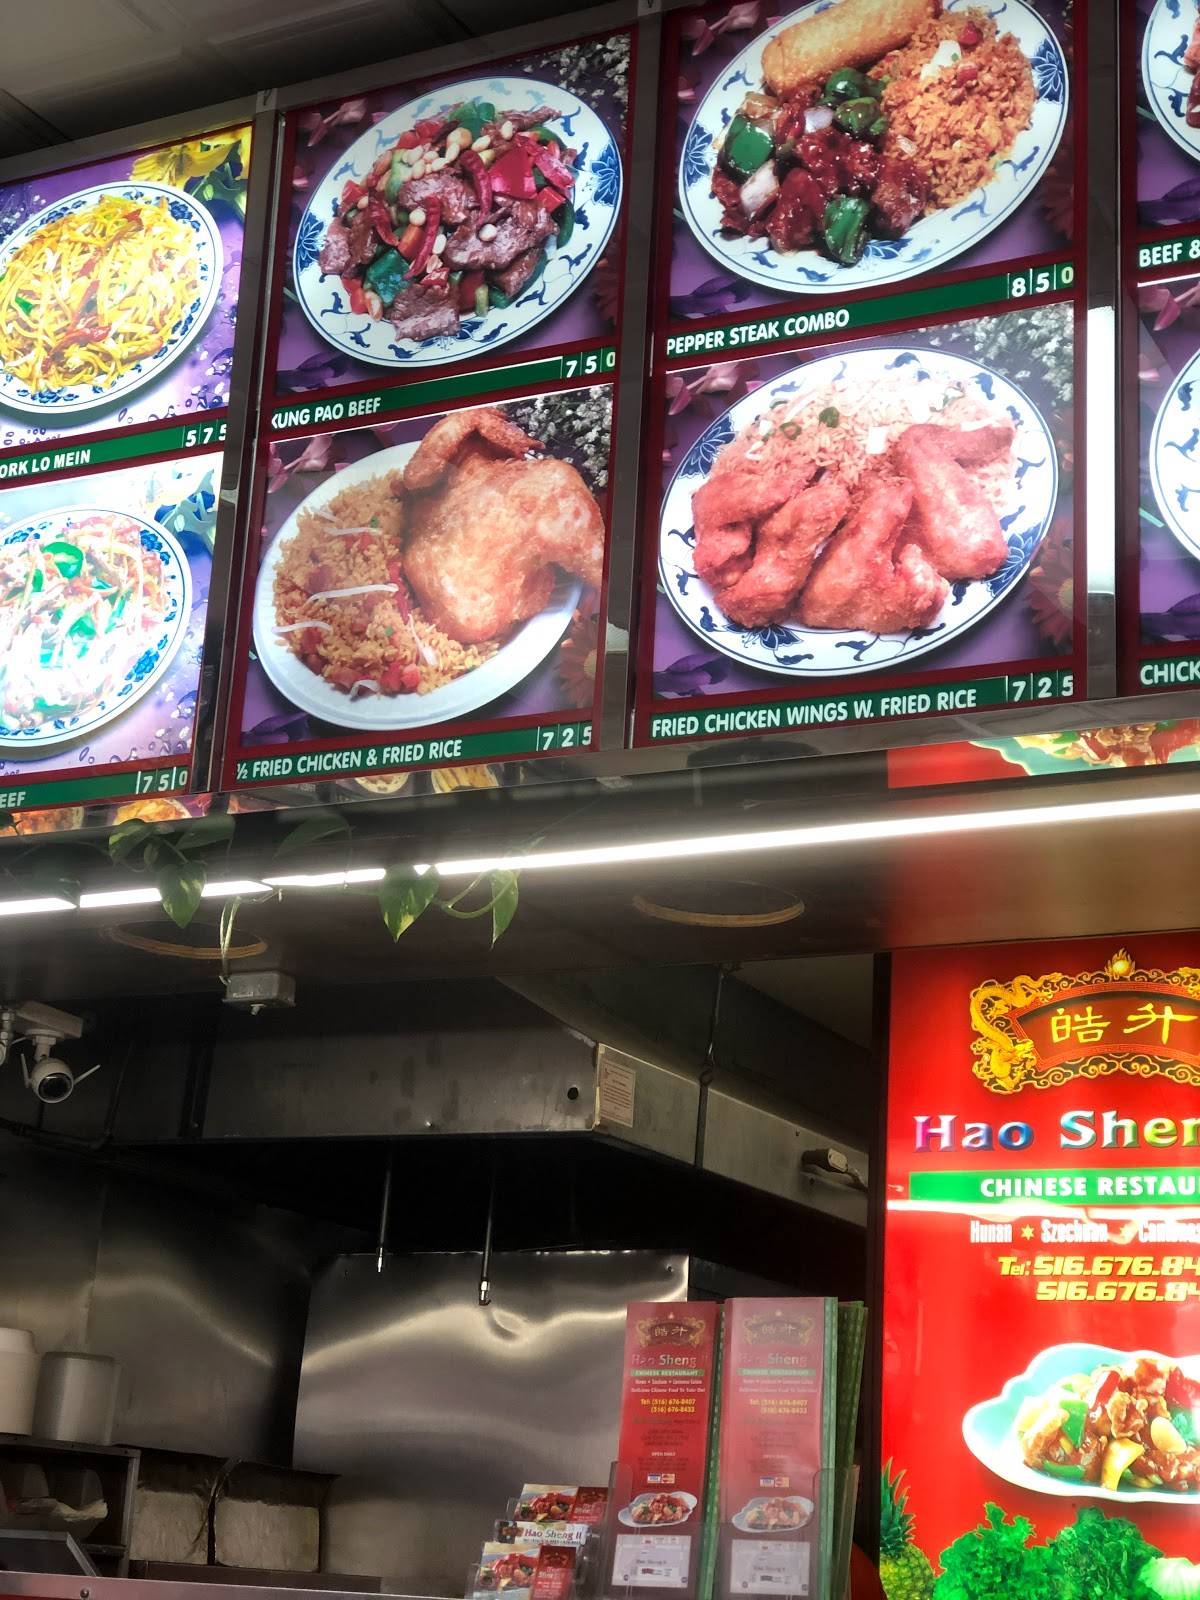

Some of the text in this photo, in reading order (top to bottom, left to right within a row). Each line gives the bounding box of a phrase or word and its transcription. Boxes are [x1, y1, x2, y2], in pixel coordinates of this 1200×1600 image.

[1138, 239, 1200, 269] BEEF &
[666, 309, 850, 356] PEPPER STEAK COMBO
[314, 403, 345, 423] PAO
[348, 397, 381, 417] BEEF
[0, 449, 91, 479] ORK LO MEIN
[1140, 660, 1200, 685] CHICK
[652, 689, 977, 738] FRIED CHICKEN WINGS W. FRIED RICE
[252, 757, 293, 778] FRIED
[297, 751, 361, 773] CHICKEN
[366, 748, 378, 767] &
[382, 743, 424, 764] FRIED
[429, 739, 462, 760] RICE
[1051, 1003, 1199, 1046] 皓升
[913, 1114, 1034, 1152] Hao
[980, 1175, 1200, 1197] CHINESE RESTAU
[970, 1220, 1012, 1243] Hunan
[998, 1256, 1200, 1277] Tel: 516.676.84
[659, 1354, 697, 1368] Sheng
[524, 1528, 543, 1538] Hao
[545, 1529, 574, 1541] Sheng
